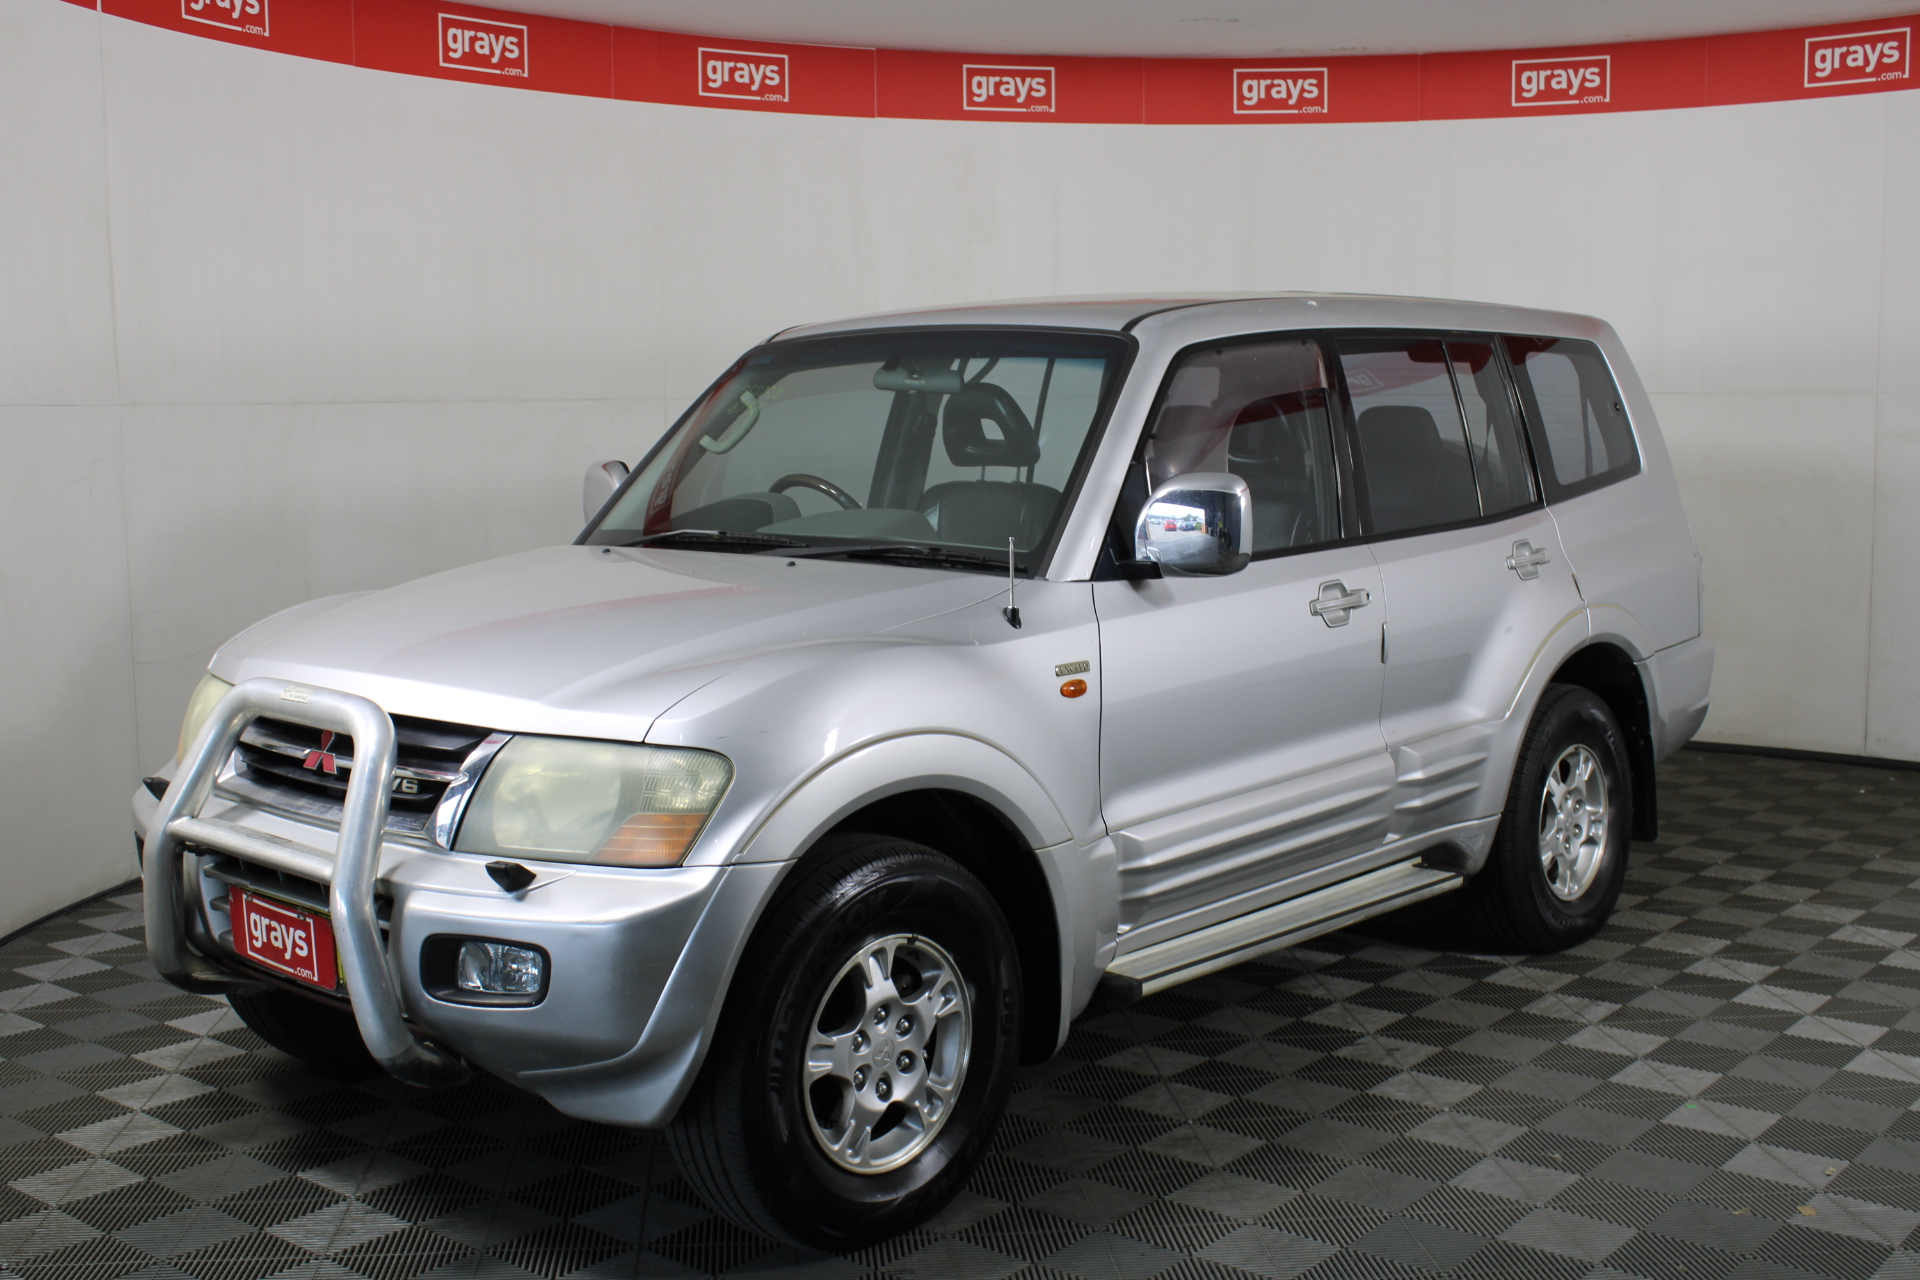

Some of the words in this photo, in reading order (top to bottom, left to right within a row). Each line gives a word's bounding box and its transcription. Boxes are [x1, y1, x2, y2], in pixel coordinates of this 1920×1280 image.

[243, 24, 264, 36] .com
[447, 27, 520, 64] grays
[1814, 41, 1900, 78] grays
[501, 67, 523, 77] .com
[706, 59, 781, 92] grays
[1878, 71, 1902, 81] .com
[1520, 66, 1601, 98] grays
[971, 75, 1047, 104] grays
[1241, 78, 1319, 106] grays
[761, 92, 783, 102] .com
[1580, 94, 1604, 104] .com
[1027, 104, 1050, 112] .com
[1299, 105, 1322, 113] .com
[250, 912, 308, 960] grays
[294, 967, 313, 981] .com
